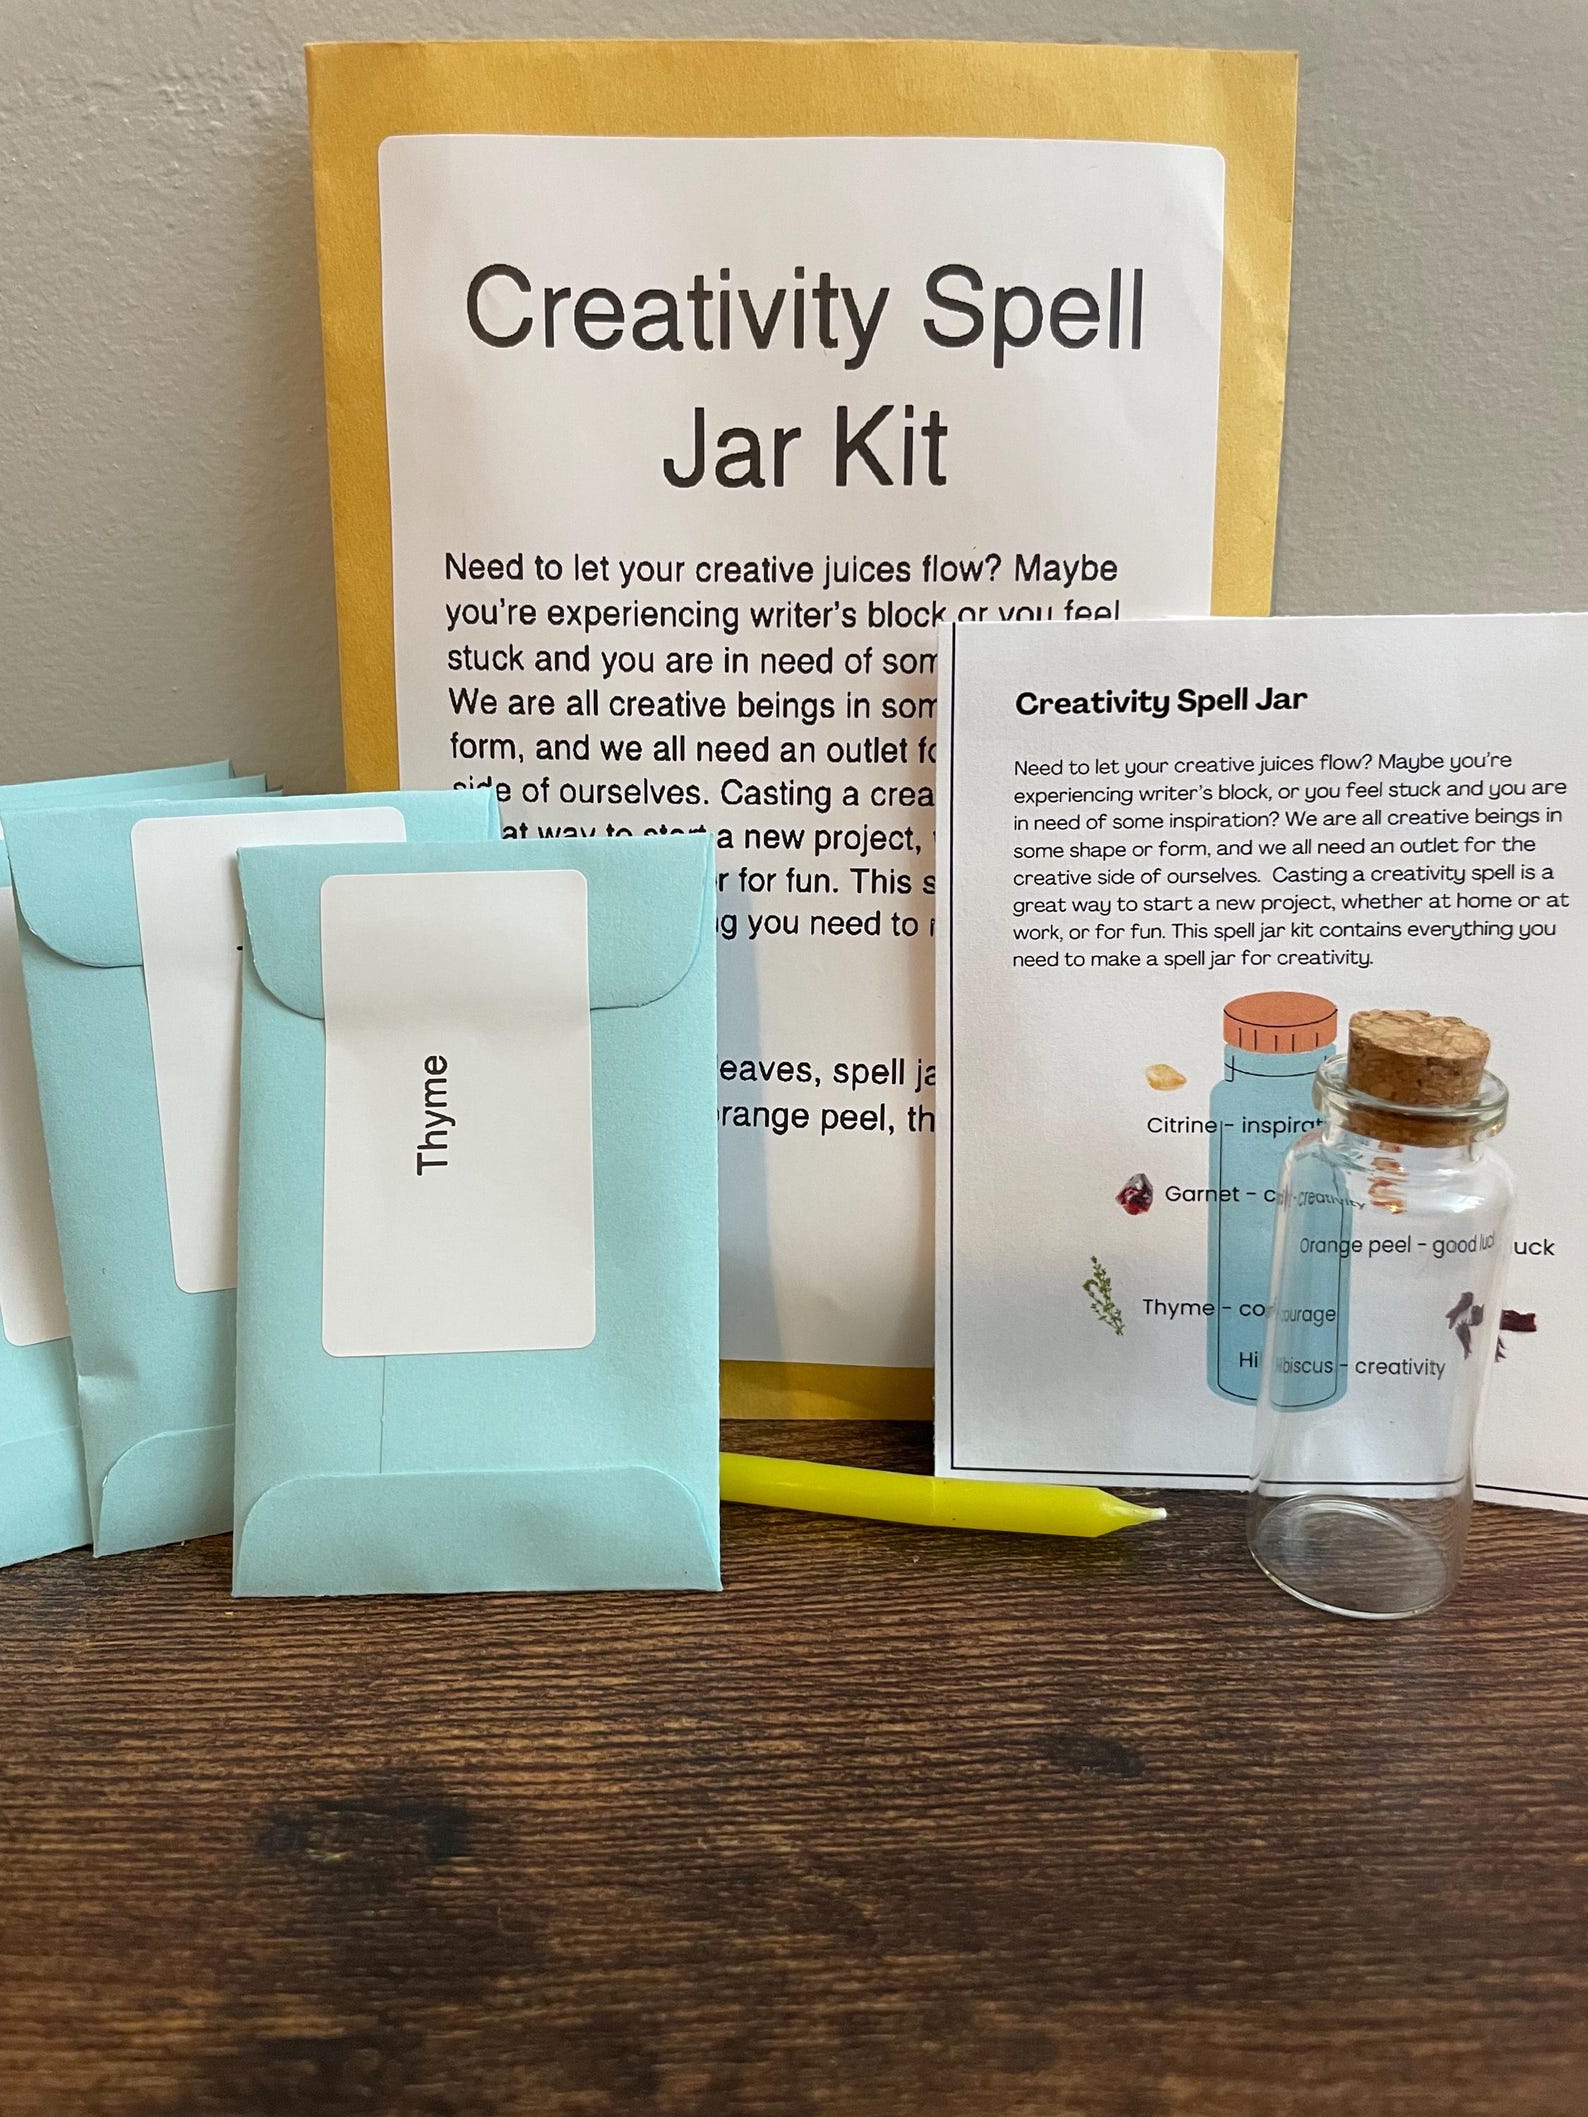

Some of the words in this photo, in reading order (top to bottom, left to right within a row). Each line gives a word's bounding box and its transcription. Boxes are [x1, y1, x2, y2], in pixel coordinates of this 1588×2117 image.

[467, 264, 890, 370] Creativity
[924, 264, 1143, 368] Spell
[664, 407, 801, 488] Jar
[836, 405, 948, 486] Kit
[445, 552, 523, 580] Need
[534, 554, 562, 580] to
[574, 553, 609, 581] let
[618, 560, 685, 589] your
[695, 555, 813, 583] creative
[822, 554, 910, 590] juices
[922, 552, 1001, 582] flow?
[1014, 553, 1117, 588] Maybe
[445, 597, 536, 632] you're
[547, 599, 738, 635] experiencing
[749, 600, 856, 628] writer's
[868, 599, 946, 628] block
[447, 643, 524, 671] stuck
[534, 644, 589, 672] and
[600, 651, 653, 679] you
[665, 651, 713, 673] are
[724, 646, 748, 673] in
[760, 646, 832, 674] need
[844, 646, 872, 674] of
[448, 687, 497, 714] We
[508, 694, 555, 715] are
[566, 688, 598, 716] all
[609, 689, 726, 717] creative
[738, 690, 835, 725] beings
[846, 691, 870, 718] in
[1015, 688, 1169, 719] Creativity
[1176, 686, 1248, 717] Spell
[1254, 686, 1308, 710] Jar
[449, 730, 523, 763] form,
[535, 733, 589, 760] and
[599, 739, 642, 761] we
[653, 734, 685, 761] all
[696, 735, 768, 762] need
[779, 741, 815, 763] an
[826, 736, 908, 763] outlet
[1014, 758, 1062, 776] Need
[1068, 760, 1089, 775] to
[1095, 758, 1120, 774] let
[1124, 760, 1168, 778] your
[1173, 756, 1254, 773] creative
[1257, 755, 1314, 776] juices
[1318, 753, 1372, 770] flow?
[1378, 752, 1444, 773] Maybe
[1448, 751, 1512, 772] you're
[522, 777, 549, 803] of
[559, 778, 709, 805] ourselves.
[721, 778, 831, 814] Casting
[842, 786, 859, 806] a
[1013, 786, 1133, 807] experiencing
[1138, 784, 1213, 801] writer's
[1218, 783, 1272, 801] block,
[1277, 786, 1299, 799] or
[1304, 786, 1340, 803] you
[1345, 781, 1382, 798] feel
[1388, 780, 1440, 797] stuck
[1446, 779, 1483, 796] and
[1488, 783, 1525, 800] you
[1531, 782, 1566, 795] are
[1013, 815, 1028, 830] in
[1034, 813, 1080, 830] need
[1085, 813, 1107, 829] of
[1112, 816, 1163, 829] some
[1169, 810, 1279, 832] inspiration?
[1284, 810, 1317, 826] We
[1322, 813, 1356, 826] are
[1361, 809, 1381, 825] all
[1387, 808, 1469, 825] creative
[1474, 807, 1540, 827] beings
[1546, 806, 1562, 822] in
[717, 828, 734, 849] a
[744, 829, 805, 849] new
[814, 824, 921, 857] project,
[1013, 846, 1064, 858] some
[1069, 841, 1126, 861] shape
[1132, 844, 1153, 857] or
[1157, 840, 1211, 857] form,
[1216, 839, 1252, 855] and
[1258, 842, 1286, 855] we
[1291, 838, 1311, 854] all
[1317, 837, 1365, 854] need
[1369, 841, 1394, 853] an
[1399, 836, 1459, 853] outlet
[1463, 835, 1496, 852] for
[1501, 835, 1535, 852] the
[738, 867, 777, 892] for
[786, 867, 839, 894] fun.
[850, 868, 912, 894] This
[1013, 869, 1091, 886] creative
[1097, 868, 1134, 885] side
[1140, 867, 1161, 884] of
[1166, 867, 1260, 884] ourselves.
[1272, 866, 1347, 886] Casting
[1352, 869, 1365, 882] a
[1370, 864, 1465, 885] creativity
[1471, 863, 1514, 884] spell
[1520, 863, 1535, 879] is
[1541, 867, 1554, 879] a
[1012, 897, 1066, 917] great
[1071, 900, 1111, 916] way
[1116, 897, 1138, 911] to
[1143, 896, 1193, 911] start
[1197, 898, 1210, 911] a
[1216, 898, 1255, 910] new
[1260, 894, 1335, 914] project,
[1341, 892, 1422, 909] whether
[1428, 893, 1451, 908] at
[1456, 892, 1512, 908] home
[1517, 895, 1540, 907] or
[1546, 892, 1569, 907] at
[748, 914, 799, 940] you
[811, 910, 881, 936] need
[891, 912, 919, 936] to
[1012, 923, 1063, 942] work,
[1068, 927, 1090, 940] or
[1094, 923, 1125, 939] for
[1130, 922, 1165, 939] fun.
[1171, 922, 1208, 938] This
[1213, 921, 1254, 942] spell
[1258, 922, 1285, 942] jar
[1290, 921, 1313, 937] kit
[1319, 921, 1401, 937] contains
[1407, 919, 1513, 940] everything
[1518, 923, 1556, 940] you
[1012, 951, 1058, 967] need
[1063, 951, 1085, 966] to
[1090, 950, 1141, 966] make
[1146, 954, 1158, 966] a
[1163, 949, 1204, 969] spell
[1207, 950, 1236, 970] jar
[1240, 948, 1271, 965] for
[1276, 949, 1373, 968] creativity.
[833, 1057, 904, 1091] spell
[416, 1055, 456, 1176] Thyme
[821, 1103, 895, 1136] peel,
[1147, 1116, 1217, 1134] Citrine
[1165, 1185, 1239, 1202] Garnet
[1300, 1237, 1362, 1259] Orange
[1369, 1235, 1411, 1258] peel
[1432, 1235, 1477, 1259] good
[1142, 1299, 1215, 1320] Thyme
[1355, 1358, 1446, 1380] creativity
